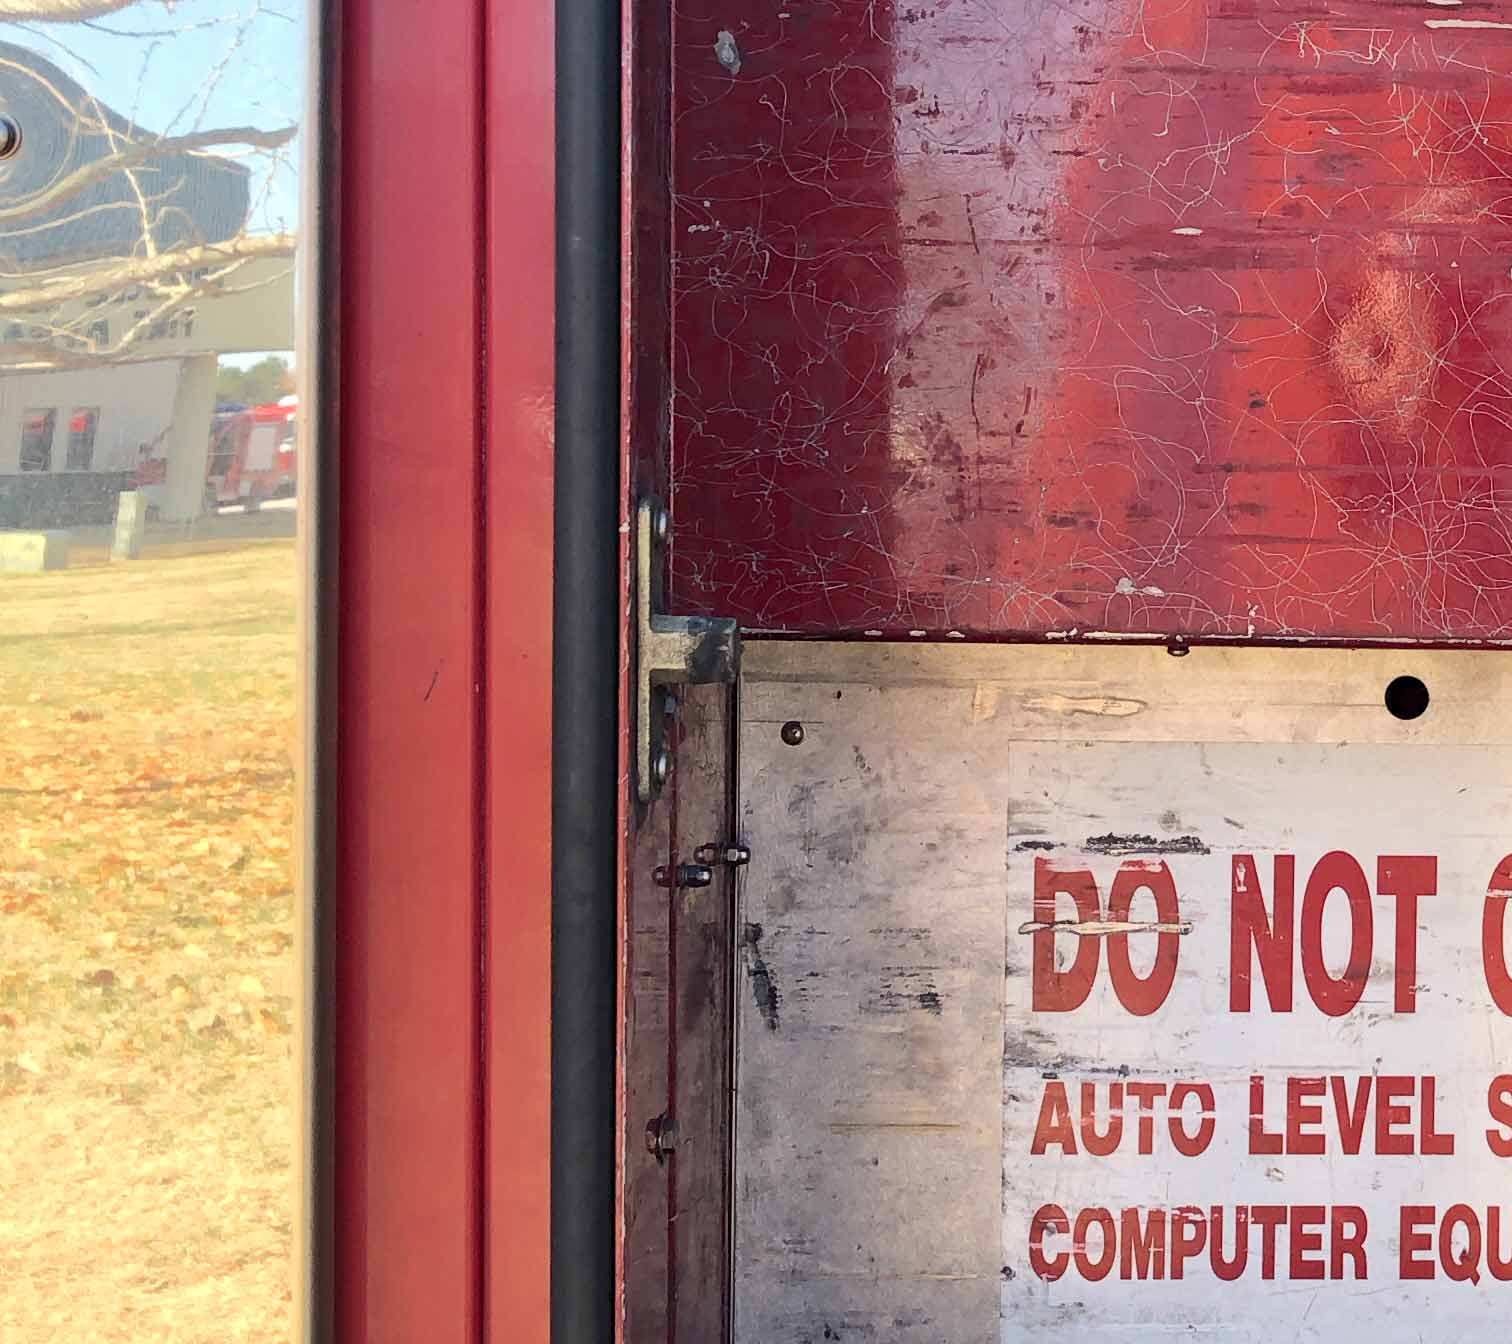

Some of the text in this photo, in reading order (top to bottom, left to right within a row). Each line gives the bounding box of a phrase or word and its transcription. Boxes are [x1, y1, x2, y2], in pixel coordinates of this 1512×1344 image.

[1031, 855, 1179, 1017] DO
[1229, 850, 1438, 1018] NOT
[1030, 1080, 1216, 1157] AUTO
[1249, 1075, 1454, 1156] LEVEL
[1029, 1203, 1369, 1282] COMPUTER
